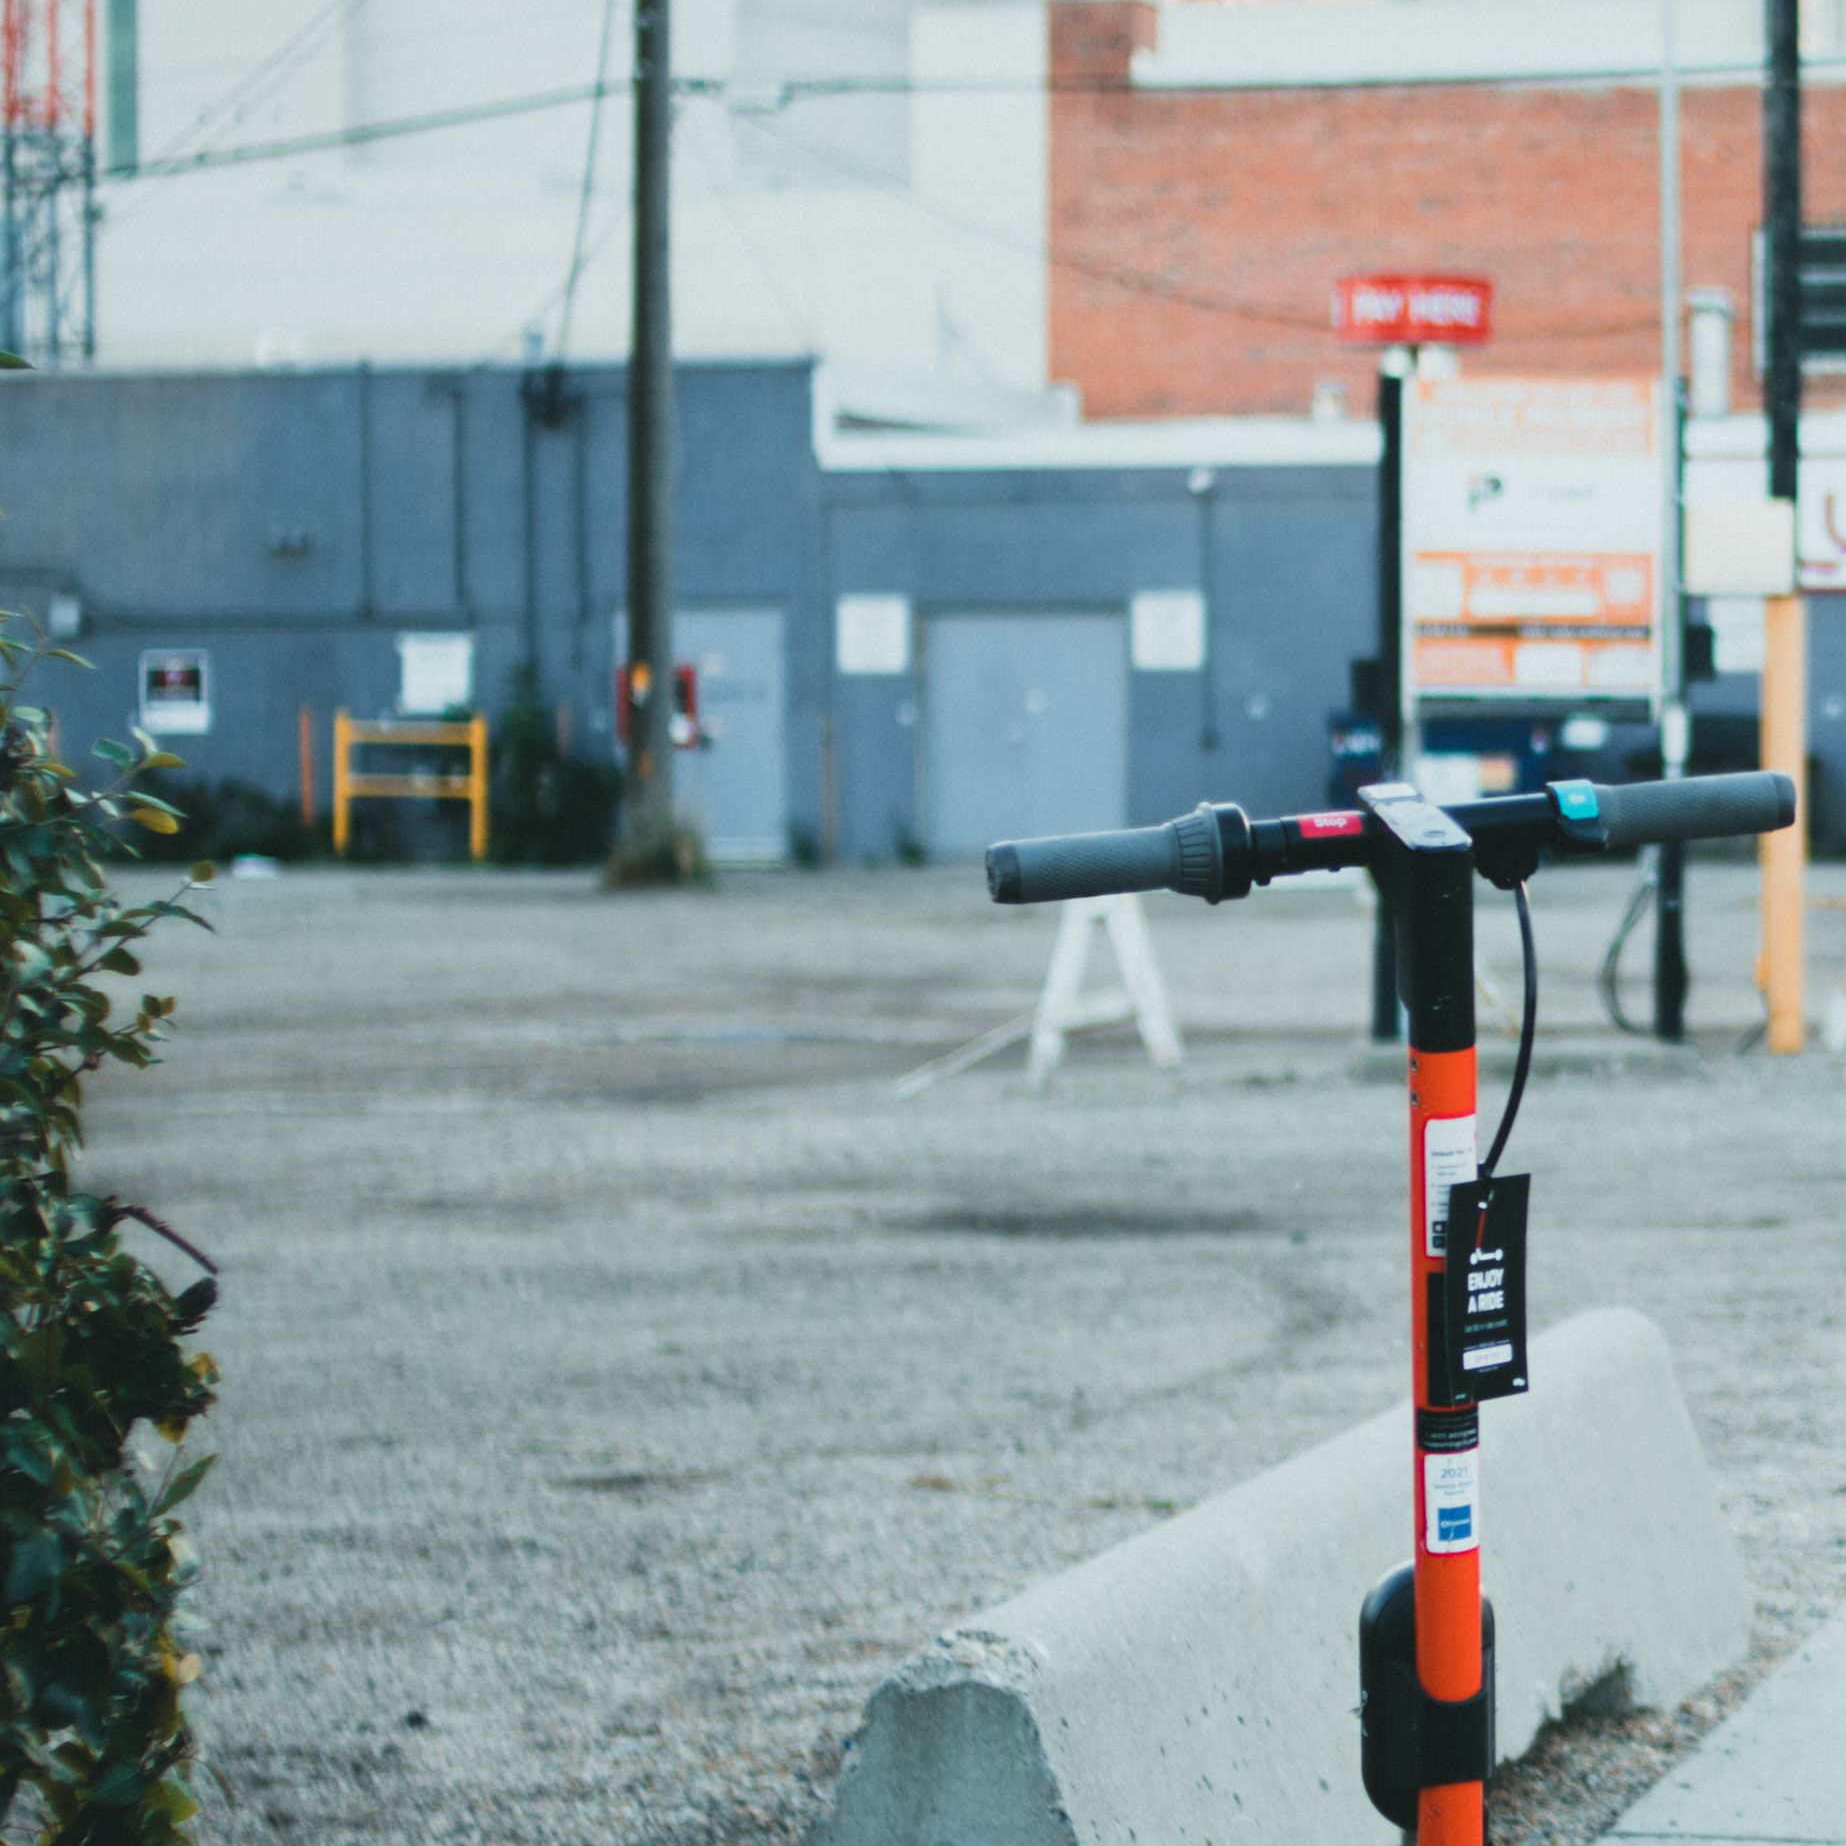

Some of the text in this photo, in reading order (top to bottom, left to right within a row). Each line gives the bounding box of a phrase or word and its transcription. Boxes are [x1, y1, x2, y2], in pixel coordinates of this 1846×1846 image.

[1314, 817, 1347, 828] Stop
[1467, 1268, 1505, 1292] ENJOY
[1467, 1290, 1505, 1314] A RIDE
[1440, 1466, 1468, 1480] 2021
